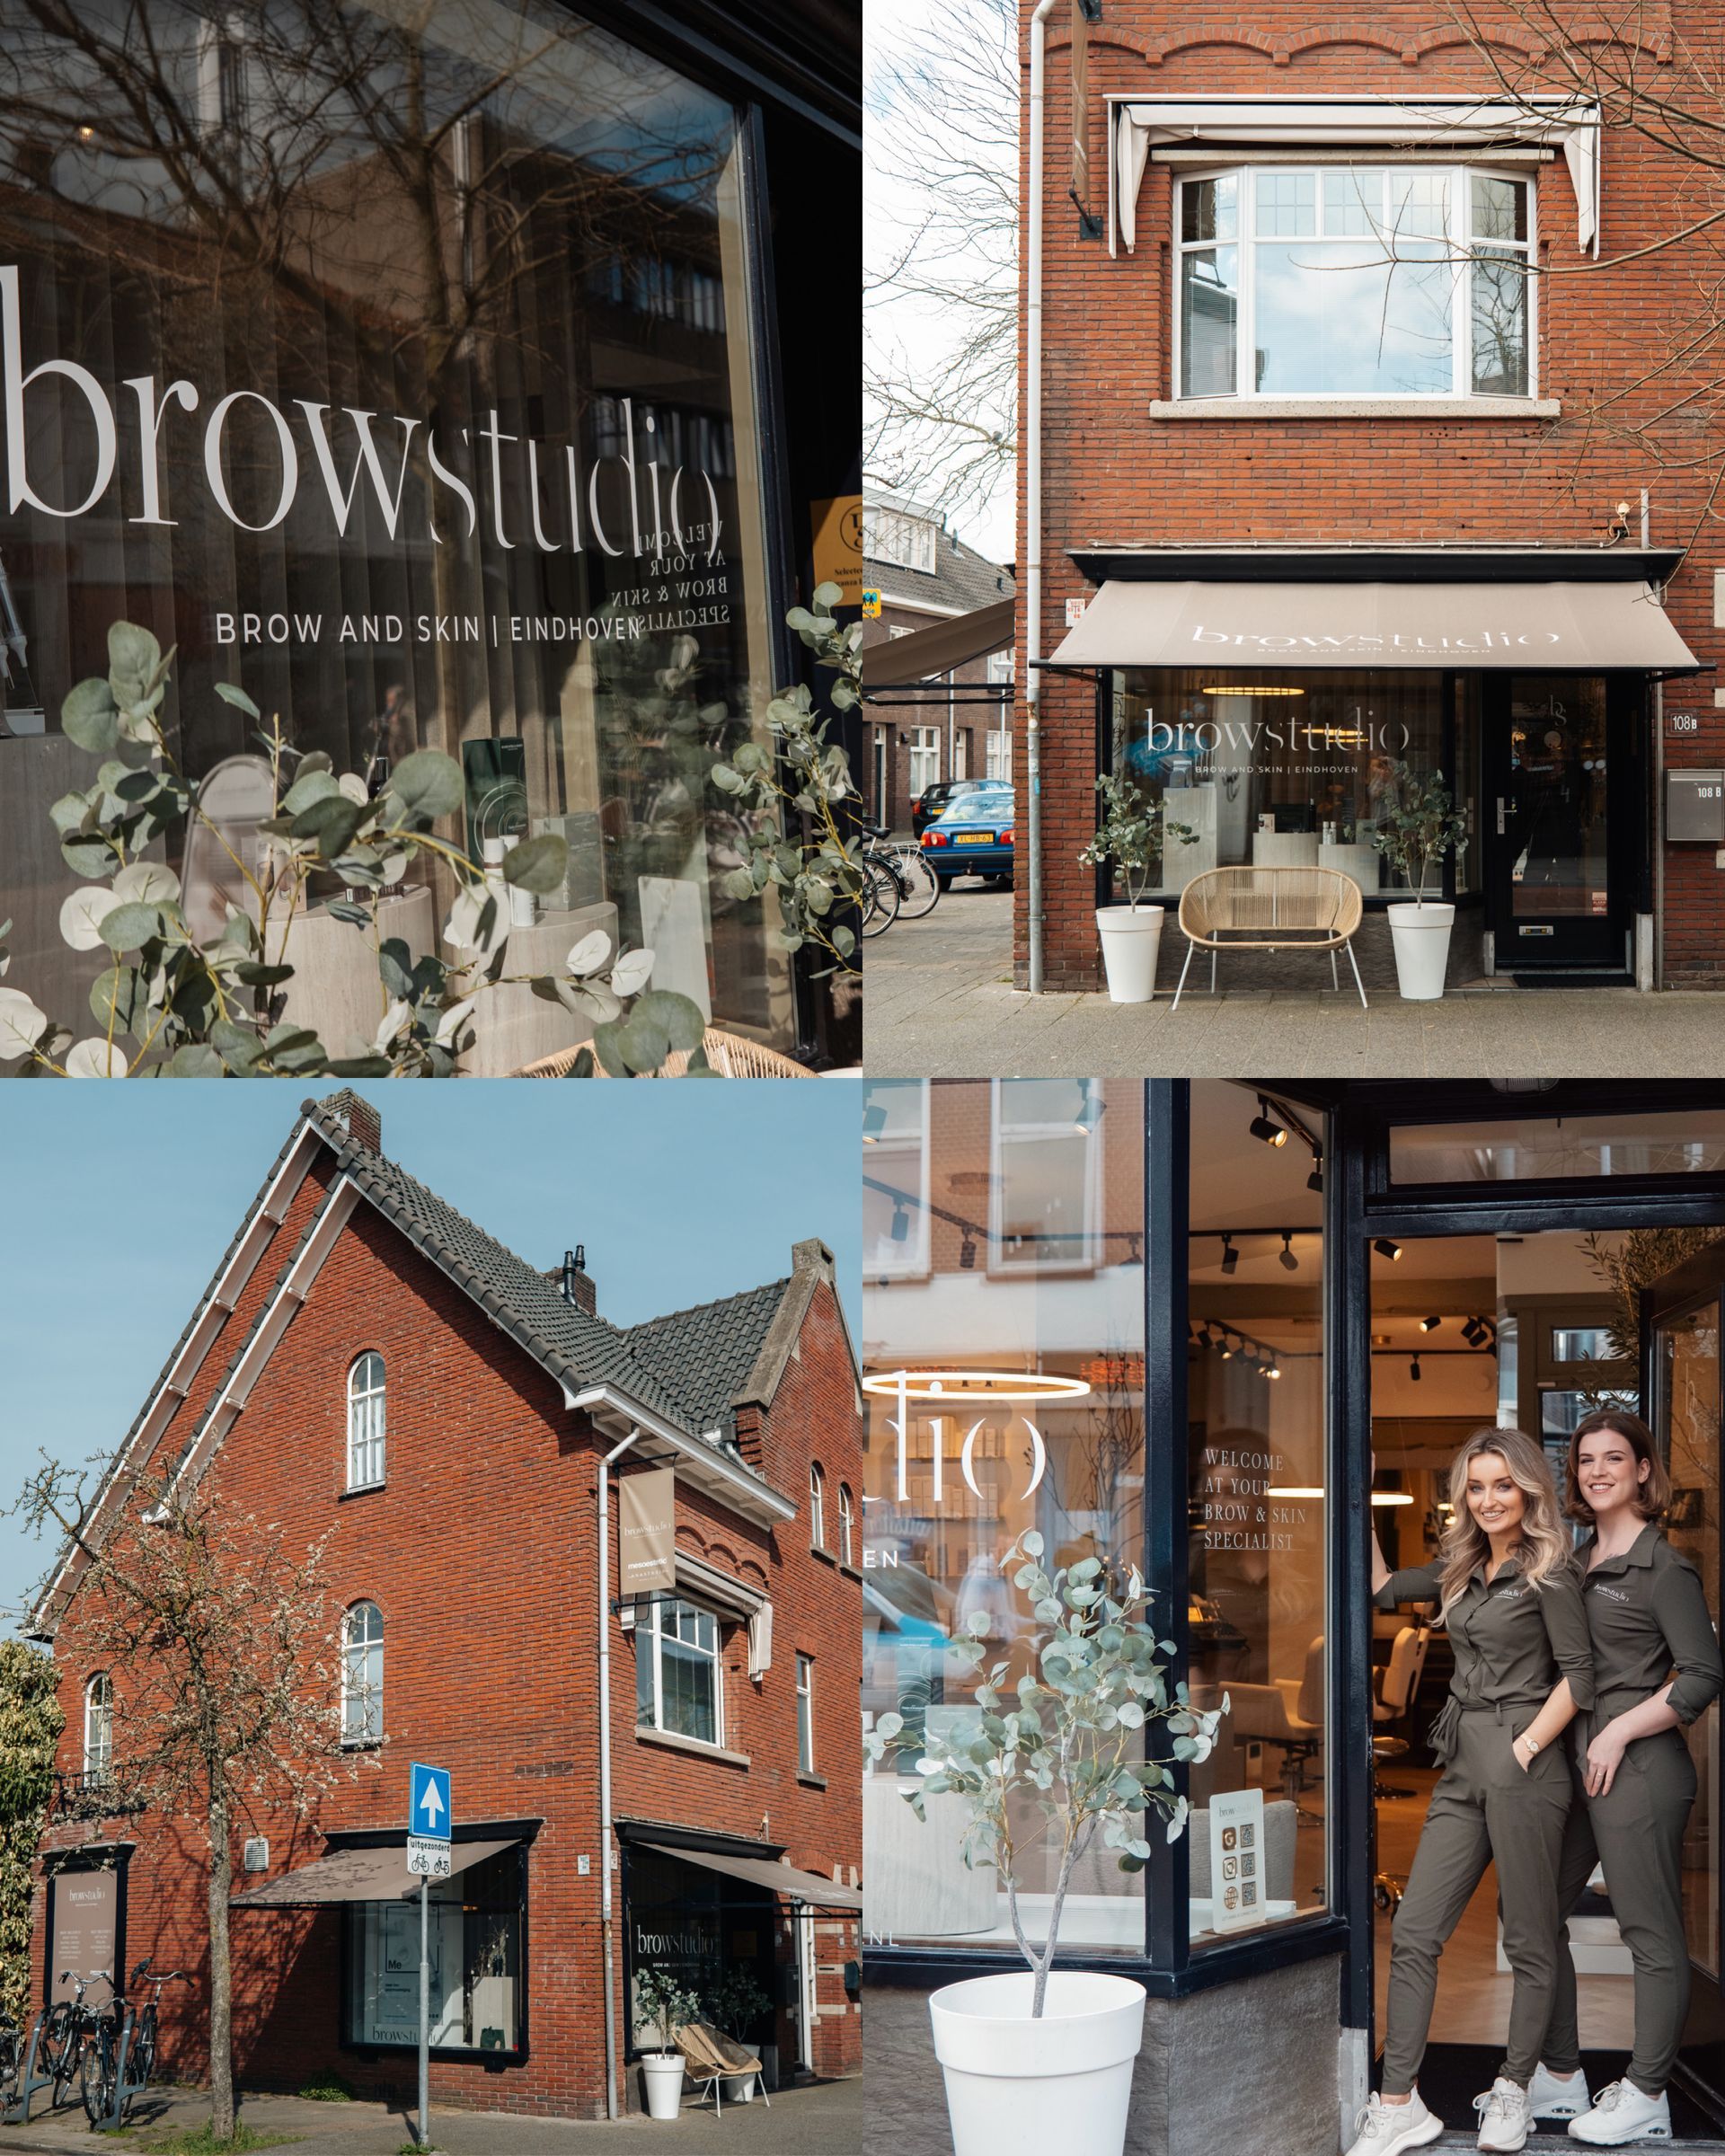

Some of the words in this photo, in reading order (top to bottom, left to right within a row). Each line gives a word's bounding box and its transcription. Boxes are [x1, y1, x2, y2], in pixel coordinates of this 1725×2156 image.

[0, 265, 719, 559] browstudio
[217, 613, 323, 644] BROW
[340, 614, 403, 643] AND
[418, 615, 480, 642] SKIN
[512, 616, 640, 641] EINDHOVEN
[1191, 626, 1560, 648] browstudio
[1145, 707, 1409, 752] browstudio
[1195, 765, 1227, 773] BROW
[1232, 765, 1254, 773] AND
[1258, 765, 1283, 773] SKIN
[1295, 765, 1358, 773] EINDHOVEN
[1697, 787, 1713, 799] 108
[1715, 786, 1721, 798] B
[1205, 1449, 1283, 1471] WELCOME
[1205, 1477, 1223, 1493] AT
[1231, 1478, 1270, 1496] YOUR
[1205, 1504, 1250, 1521] BROW
[1256, 1507, 1266, 1522] &
[1272, 1508, 1306, 1524] SKIN
[1204, 1531, 1294, 1550] SPECIALIST
[411, 1841, 450, 1852] uitgezonderd
[637, 1925, 713, 1954] browstudio
[388, 1959, 402, 1970] Me
